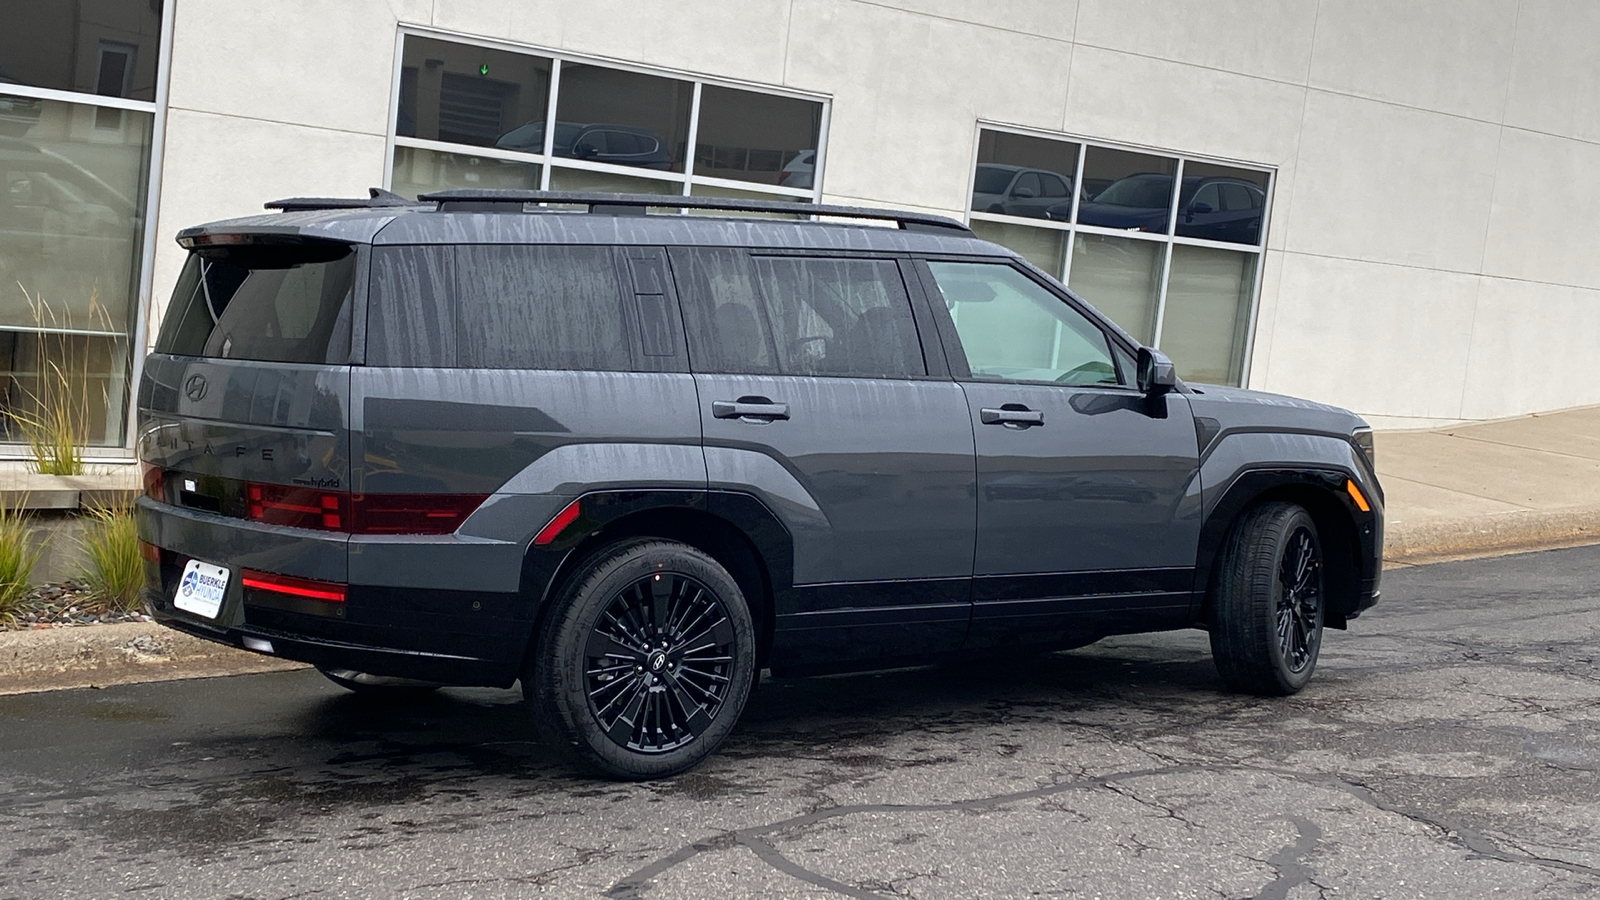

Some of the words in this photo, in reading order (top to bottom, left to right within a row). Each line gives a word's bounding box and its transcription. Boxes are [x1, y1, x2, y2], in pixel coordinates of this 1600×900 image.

[235, 446, 275, 461] FE
[310, 476, 341, 489] hybrid
[199, 574, 226, 590] BUERKLE
